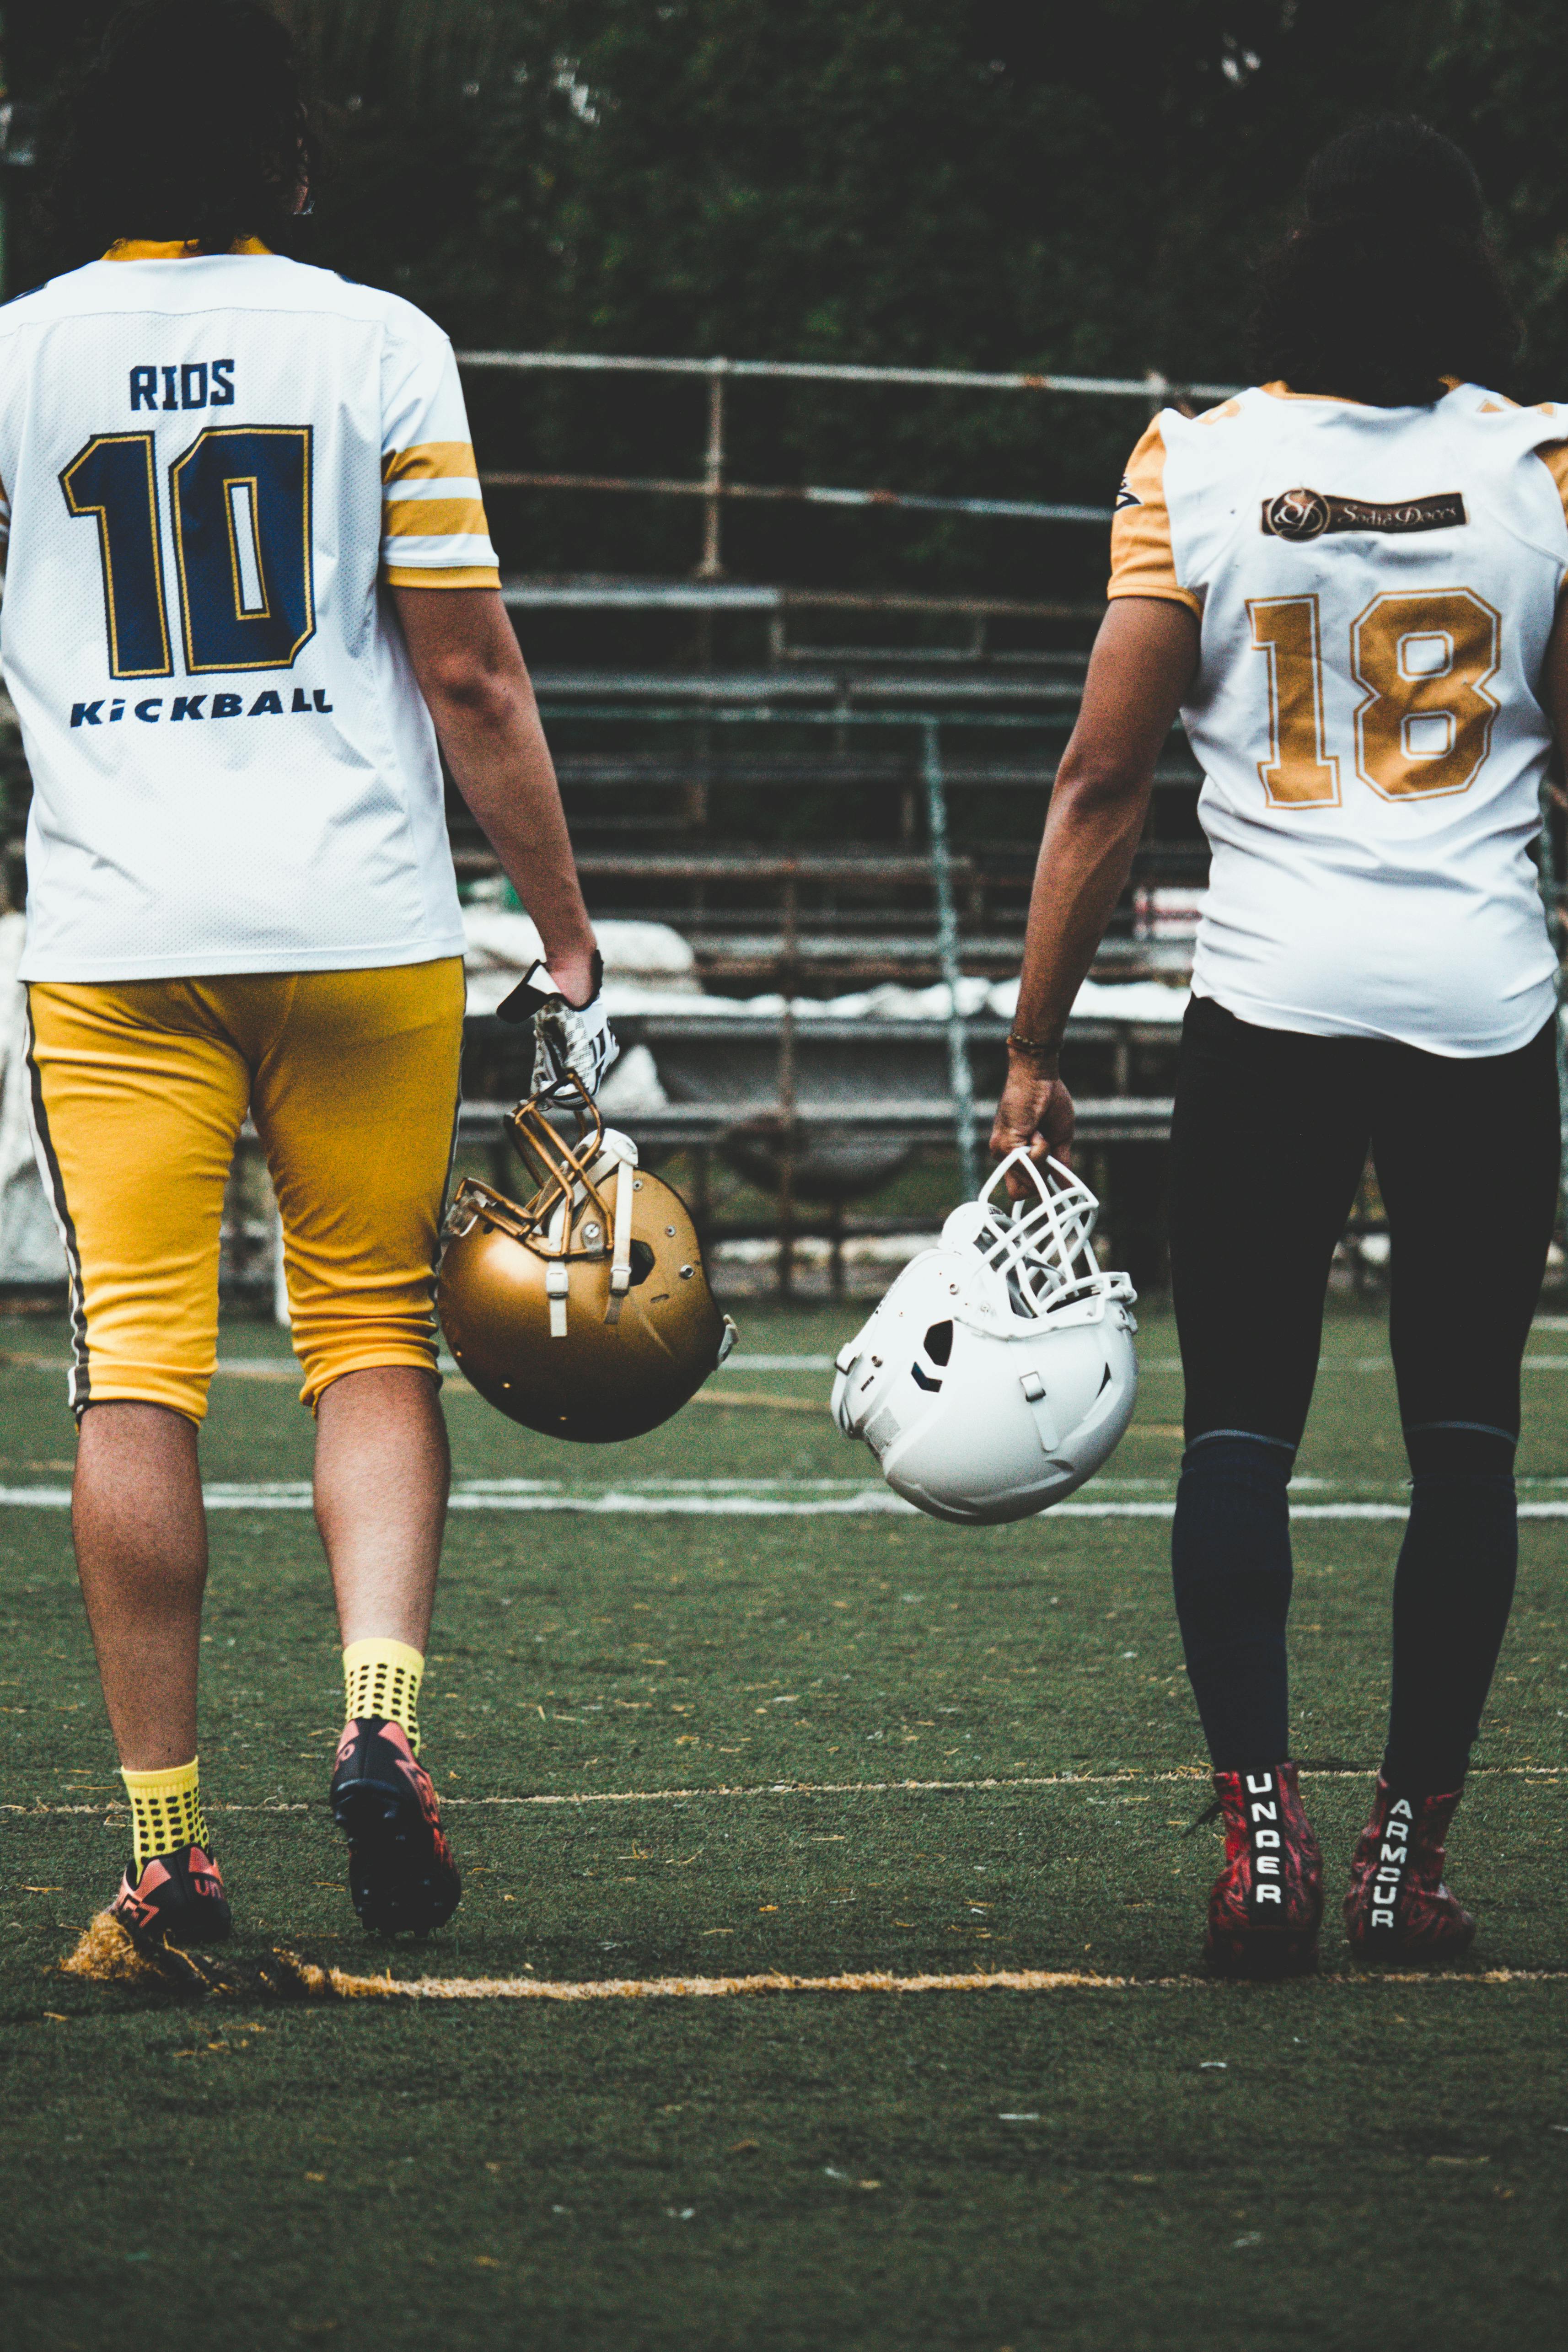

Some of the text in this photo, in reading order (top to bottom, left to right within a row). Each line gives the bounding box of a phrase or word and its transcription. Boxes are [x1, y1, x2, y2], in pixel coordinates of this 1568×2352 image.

[130, 359, 235, 411] RIOS
[58, 424, 317, 681] 10
[1245, 587, 1501, 810] 18
[1246, 1772, 1281, 1904] UNDER
[1371, 1799, 1412, 1928] ARMOUR
